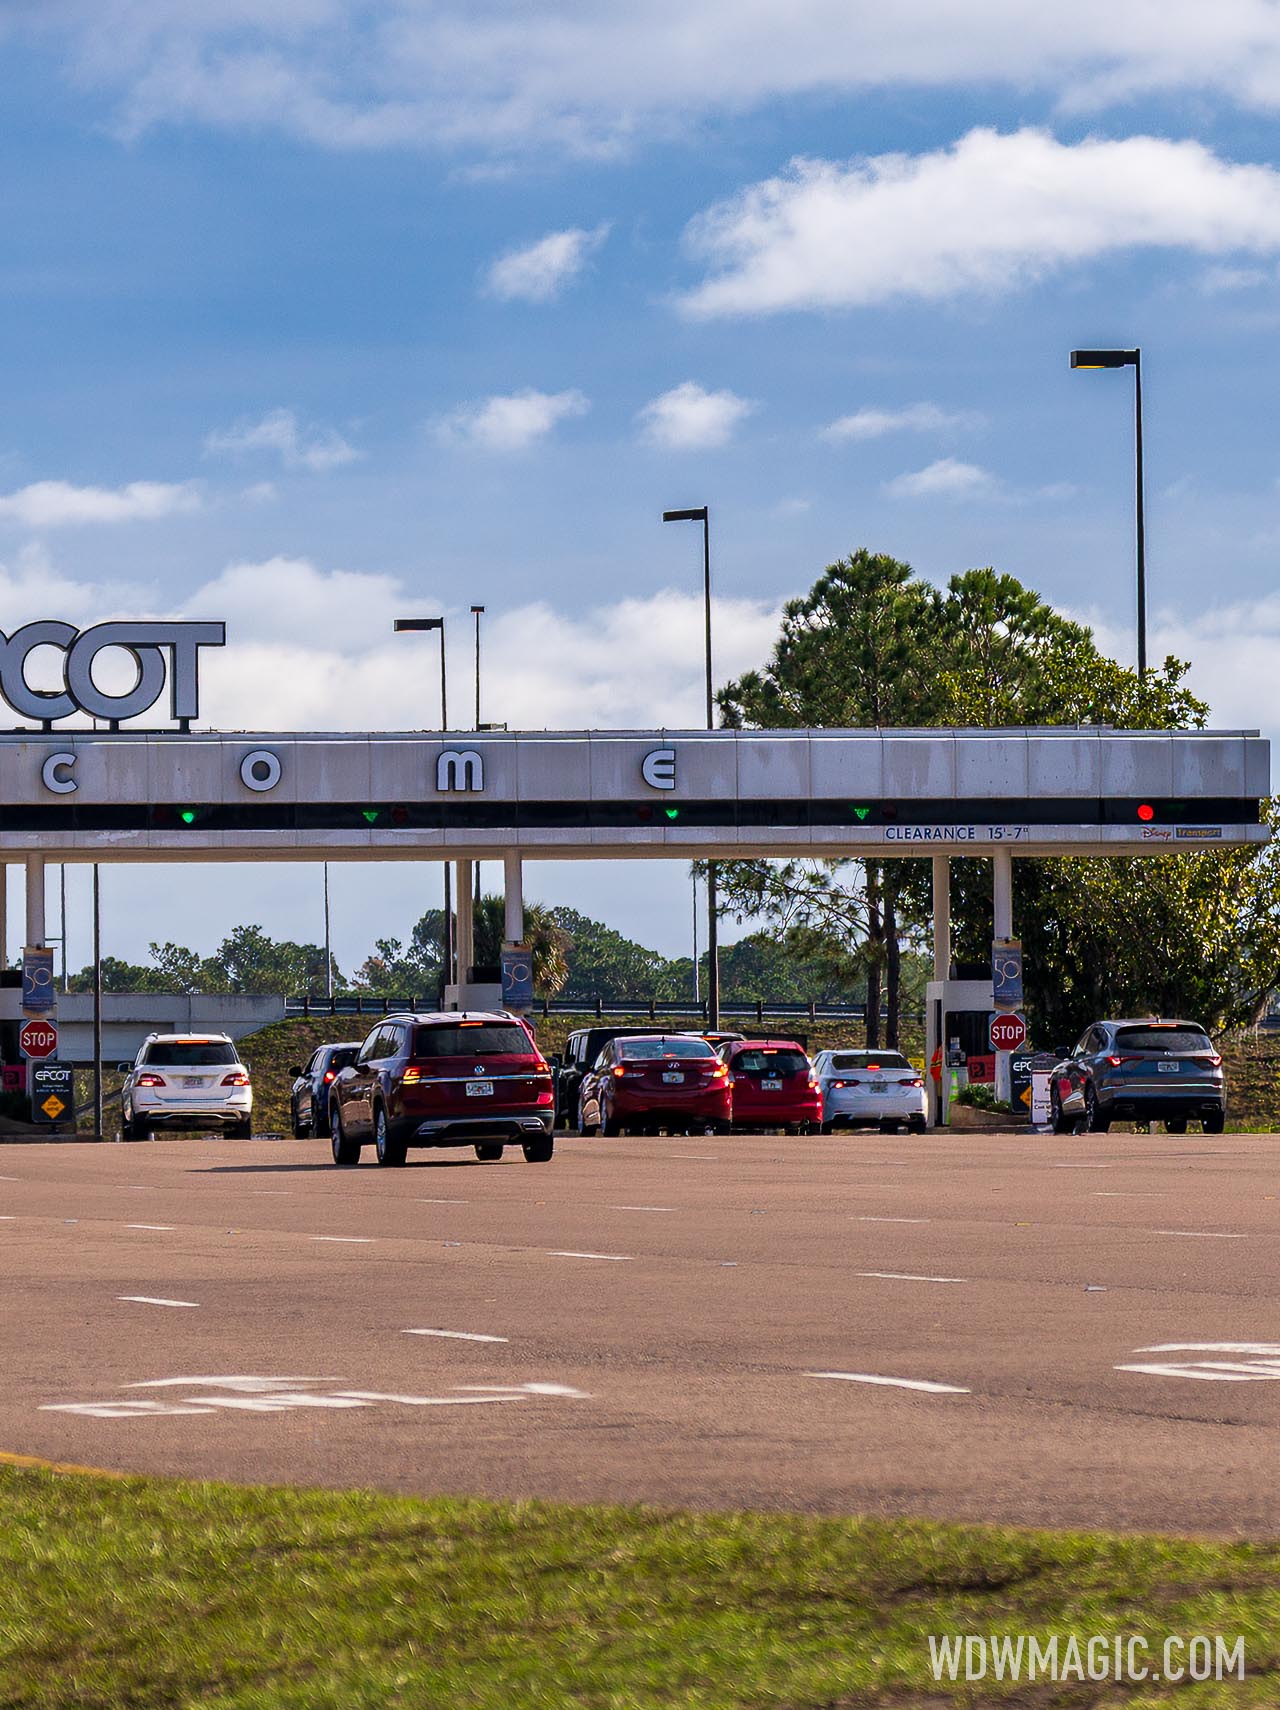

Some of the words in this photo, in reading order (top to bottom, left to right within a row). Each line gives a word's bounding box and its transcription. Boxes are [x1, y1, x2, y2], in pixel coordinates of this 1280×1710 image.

[885, 827, 976, 840] CLEARANCE
[1139, 826, 1171, 841] Disney
[24, 966, 52, 995] 50
[994, 959, 1020, 988] 50
[23, 1032, 55, 1046] STOP
[992, 1026, 1023, 1040] STOP
[1012, 1061, 1031, 1072] EPC
[35, 1070, 71, 1081] EPCOT
